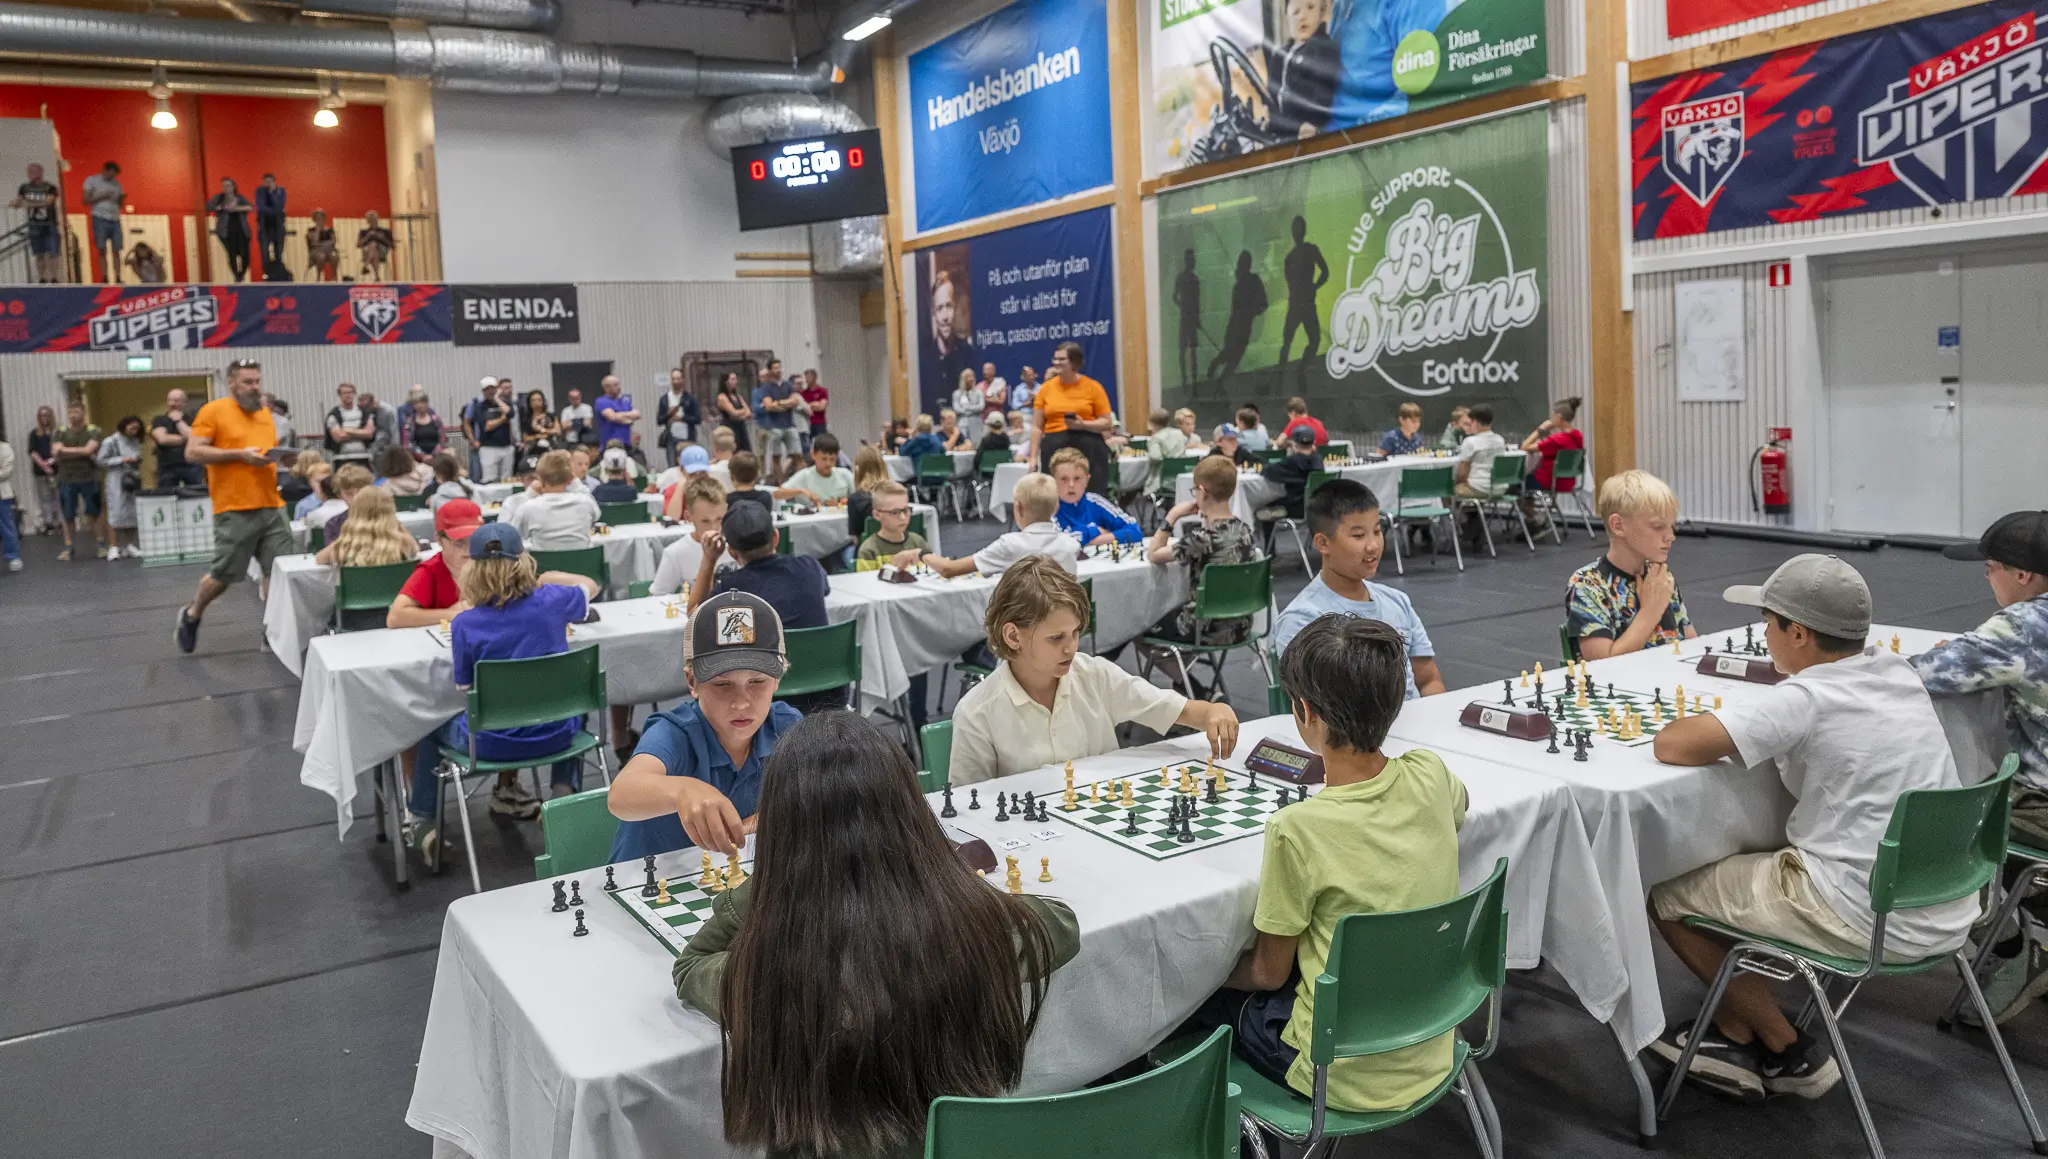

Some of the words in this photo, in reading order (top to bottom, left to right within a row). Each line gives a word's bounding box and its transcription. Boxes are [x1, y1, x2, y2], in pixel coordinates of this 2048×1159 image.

[1448, 29, 1481, 51] Dina
[1448, 34, 1538, 71] Försäkringar
[1915, 20, 2029, 89] VÄXJÖ
[1395, 49, 1435, 75] dina
[927, 46, 1081, 131] Handelsbanken
[1867, 47, 2048, 158] VIPER
[1666, 97, 1738, 125] VÄXJÖ
[978, 118, 1021, 155] Växjö
[750, 160, 766, 180] 0
[772, 149, 840, 178] 00:00
[847, 147, 864, 168] 0
[1373, 198, 1482, 301] Big
[988, 267, 1001, 287] På
[1002, 266, 1021, 285] och
[1022, 258, 1061, 282] utanför
[1063, 254, 1089, 279] plan
[463, 297, 574, 320] ENENDA.
[1000, 294, 1019, 315] står
[1020, 294, 1031, 312] vi
[1032, 290, 1059, 311] alltid
[1060, 287, 1078, 307] för
[94, 300, 214, 344] VIPERS
[1007, 324, 1047, 347] passion
[1048, 320, 1070, 340] och
[1071, 319, 1111, 338] ansvar
[1326, 268, 1540, 379] Dreams
[1422, 357, 1520, 385] Fortnox
